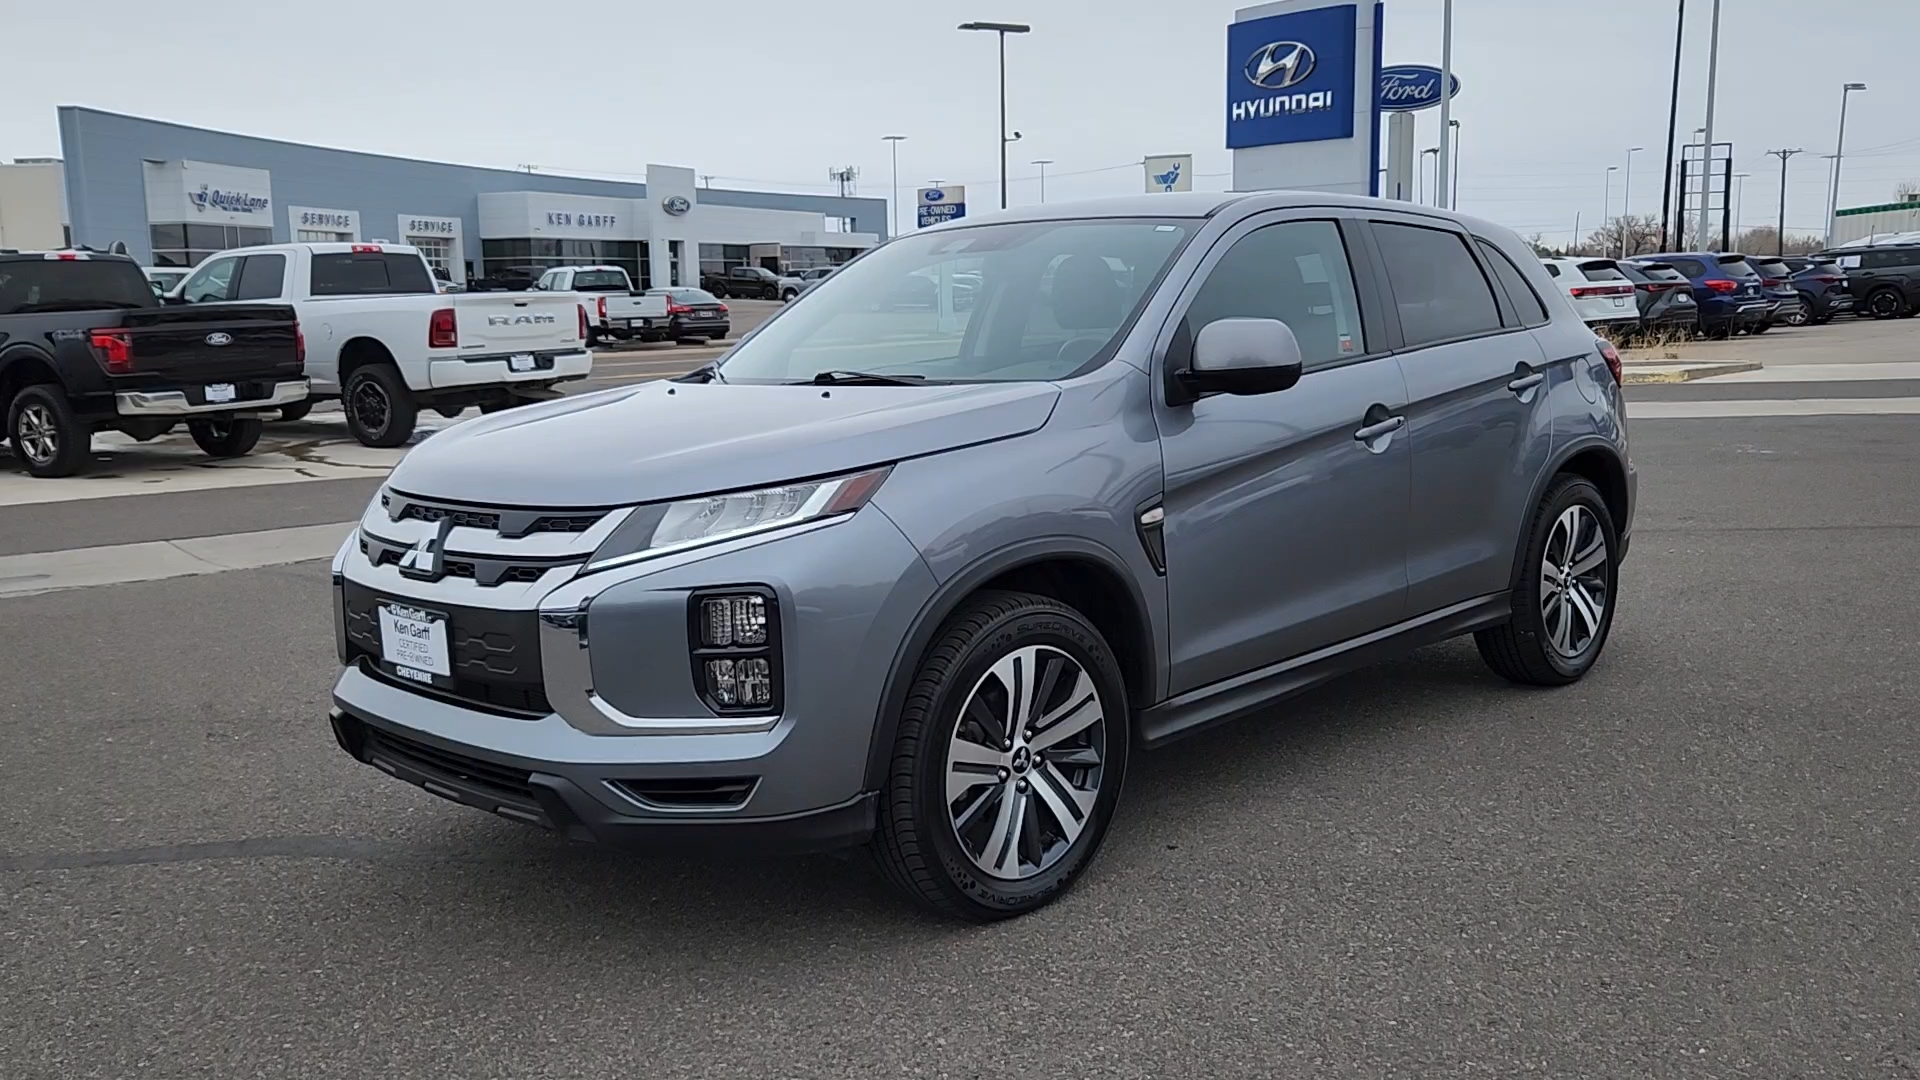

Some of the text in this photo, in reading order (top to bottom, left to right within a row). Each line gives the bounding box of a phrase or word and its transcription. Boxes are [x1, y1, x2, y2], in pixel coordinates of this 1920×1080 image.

[1381, 73, 1435, 100] Ford
[1231, 91, 1332, 121] HYUNDAI
[211, 190, 268, 208] Quick Lane
[302, 212, 350, 227] SERVICE
[410, 220, 453, 233] SERVICE
[548, 212, 616, 228] KEN GARFF
[488, 315, 555, 326] RAM
[394, 619, 430, 640] Ken Garff
[399, 638, 429, 654] CERTIFIED
[396, 665, 433, 684] CHEYENNE
